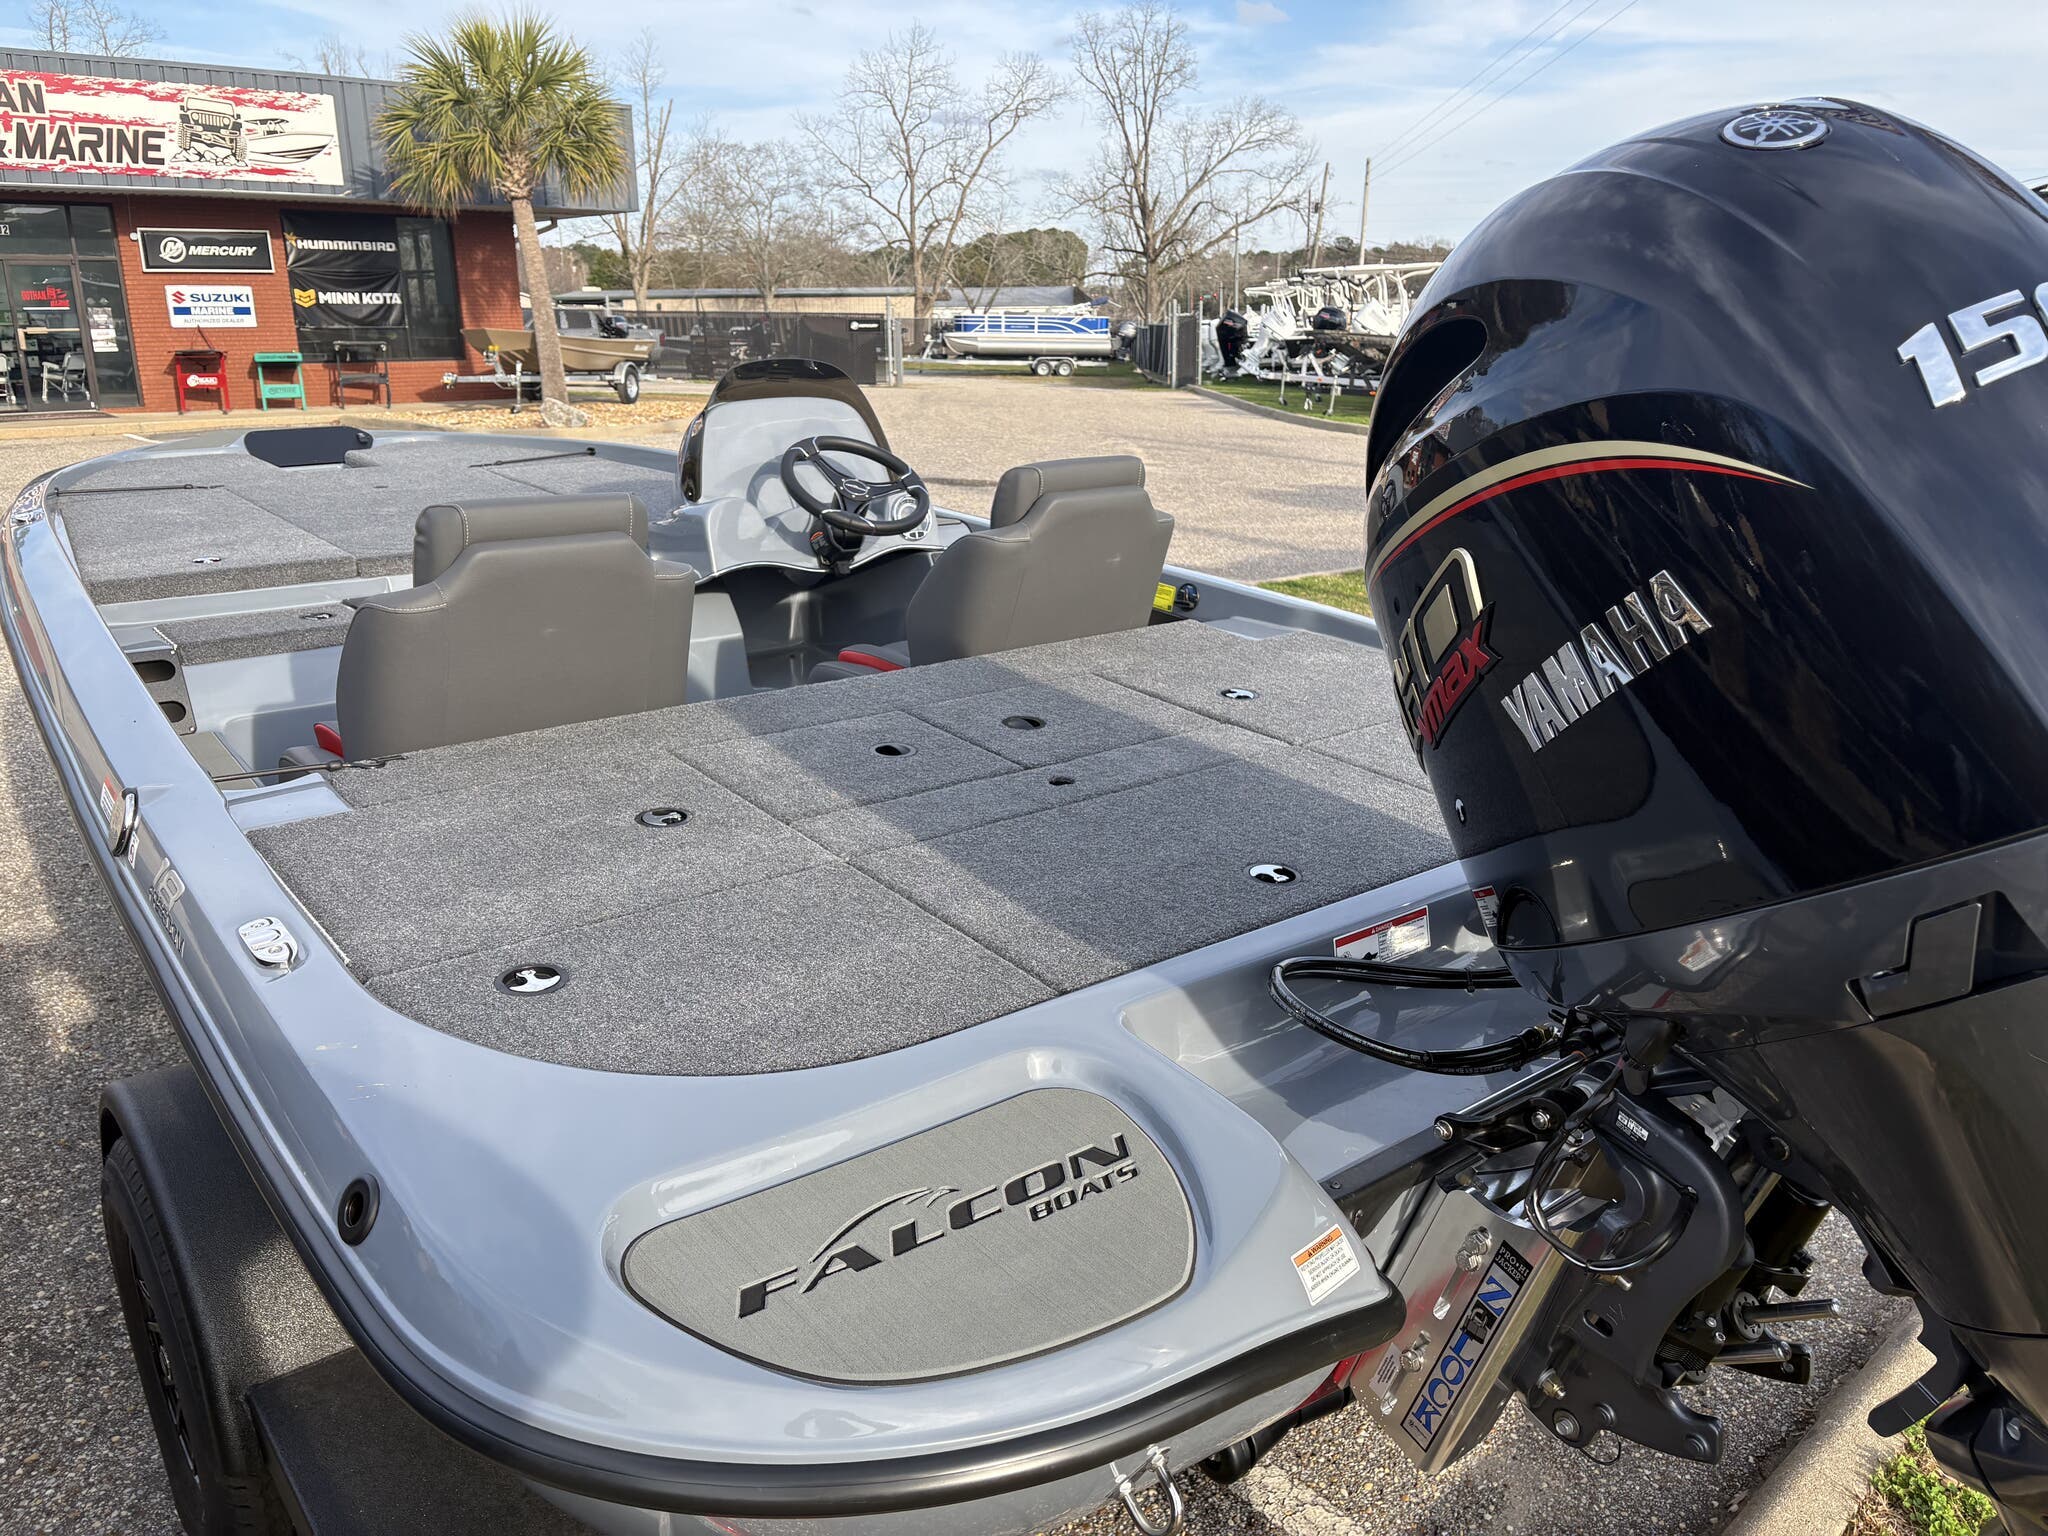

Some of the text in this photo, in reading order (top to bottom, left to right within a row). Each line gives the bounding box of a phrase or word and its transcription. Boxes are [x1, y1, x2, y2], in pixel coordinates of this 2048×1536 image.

[0, 81, 46, 114] AN
[15, 121, 166, 165] MARINE
[188, 245, 257, 256] MERCURY
[190, 293, 250, 303] SUZUKI
[191, 306, 234, 315] MARINE
[318, 291, 403, 305] MINN KOTA
[1500, 569, 1715, 753] YAMAHA
[1030, 1161, 1138, 1222] BOATS
[738, 1133, 1129, 1319] FALCON
[1311, 1235, 1333, 1253] WARNING
